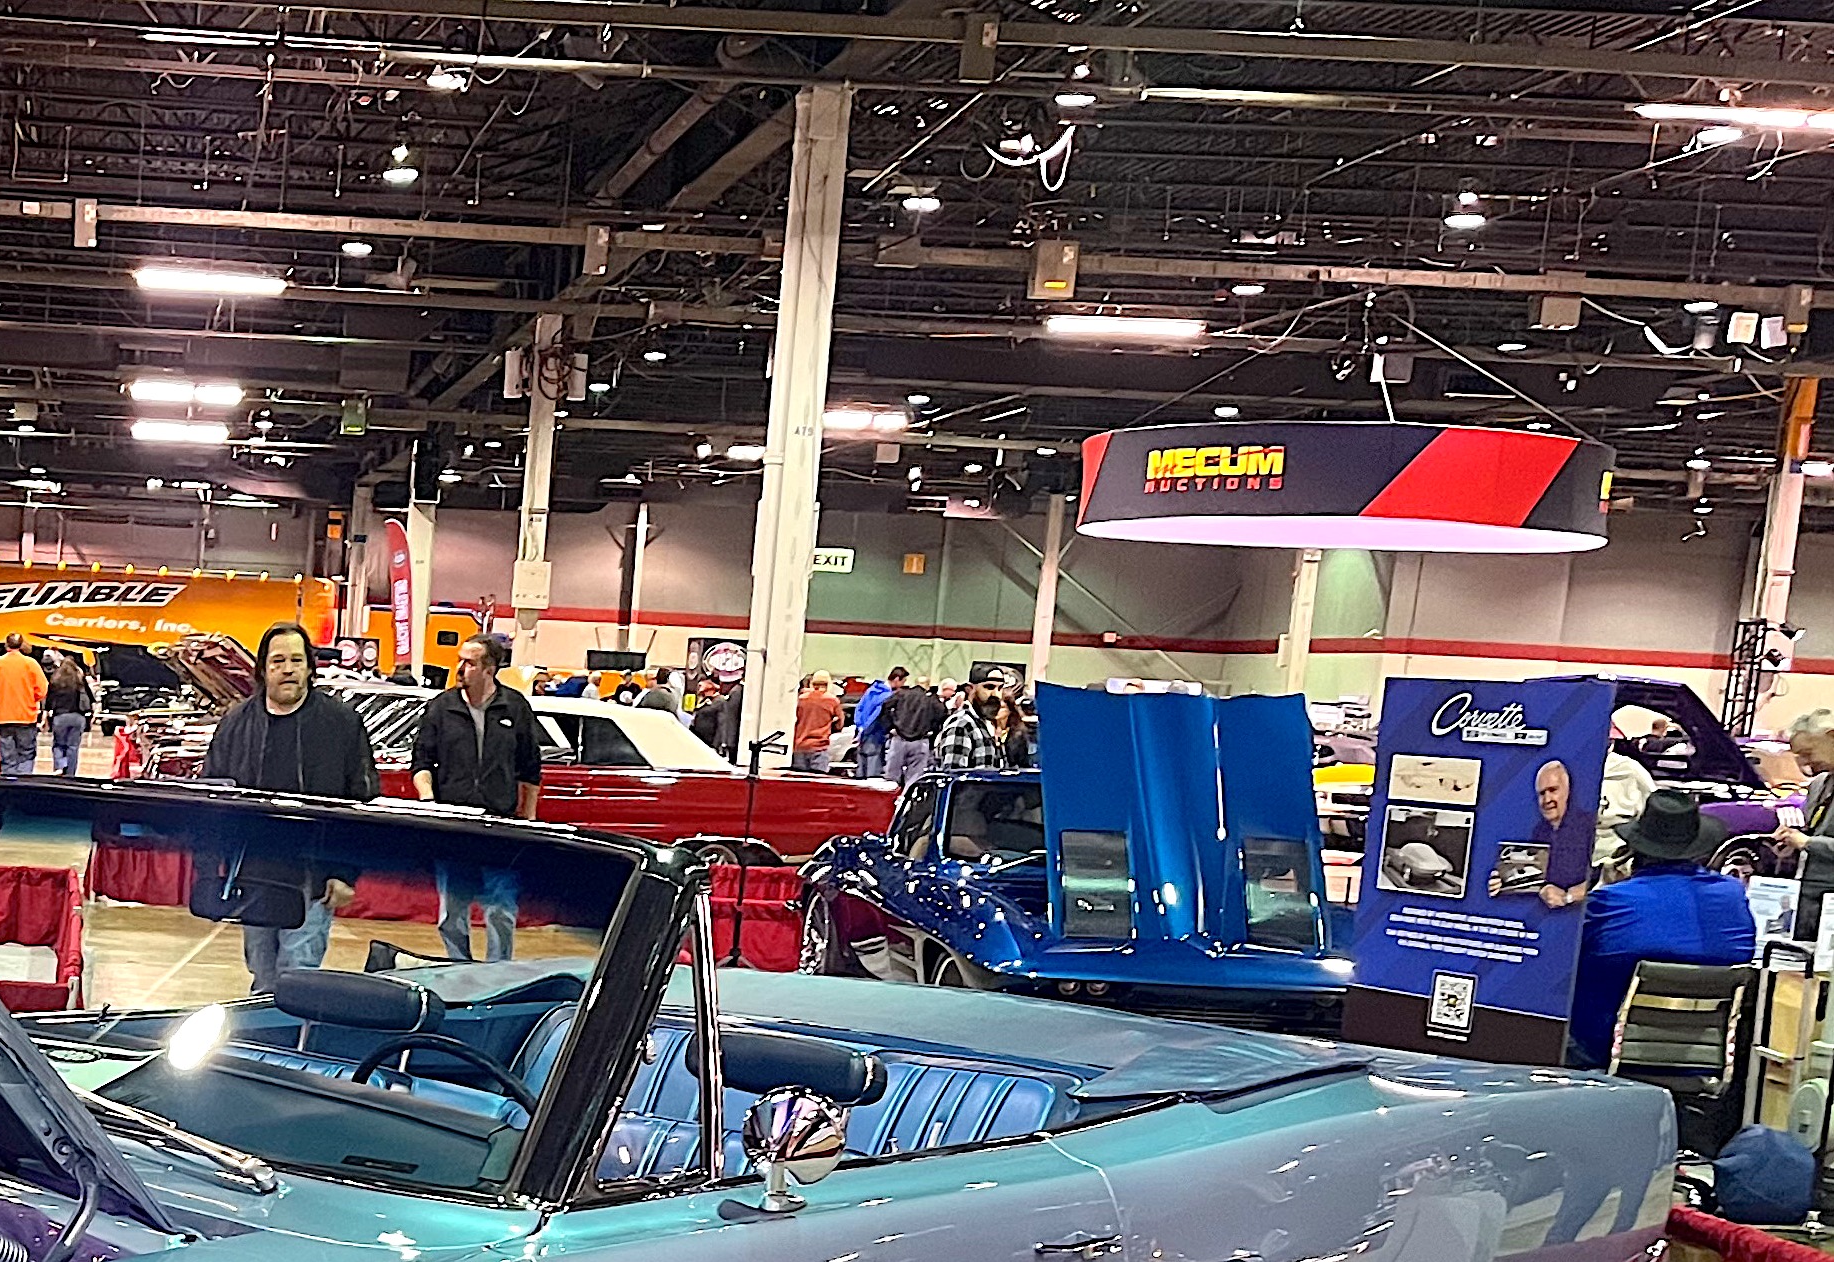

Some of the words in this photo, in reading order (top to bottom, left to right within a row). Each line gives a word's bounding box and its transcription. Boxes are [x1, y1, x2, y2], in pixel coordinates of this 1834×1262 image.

[1145, 445, 1285, 479] MECUM
[1144, 477, 1284, 493] AUCTIONS
[813, 554, 849, 567] EXIT
[1431, 692, 1527, 736] Corvette
